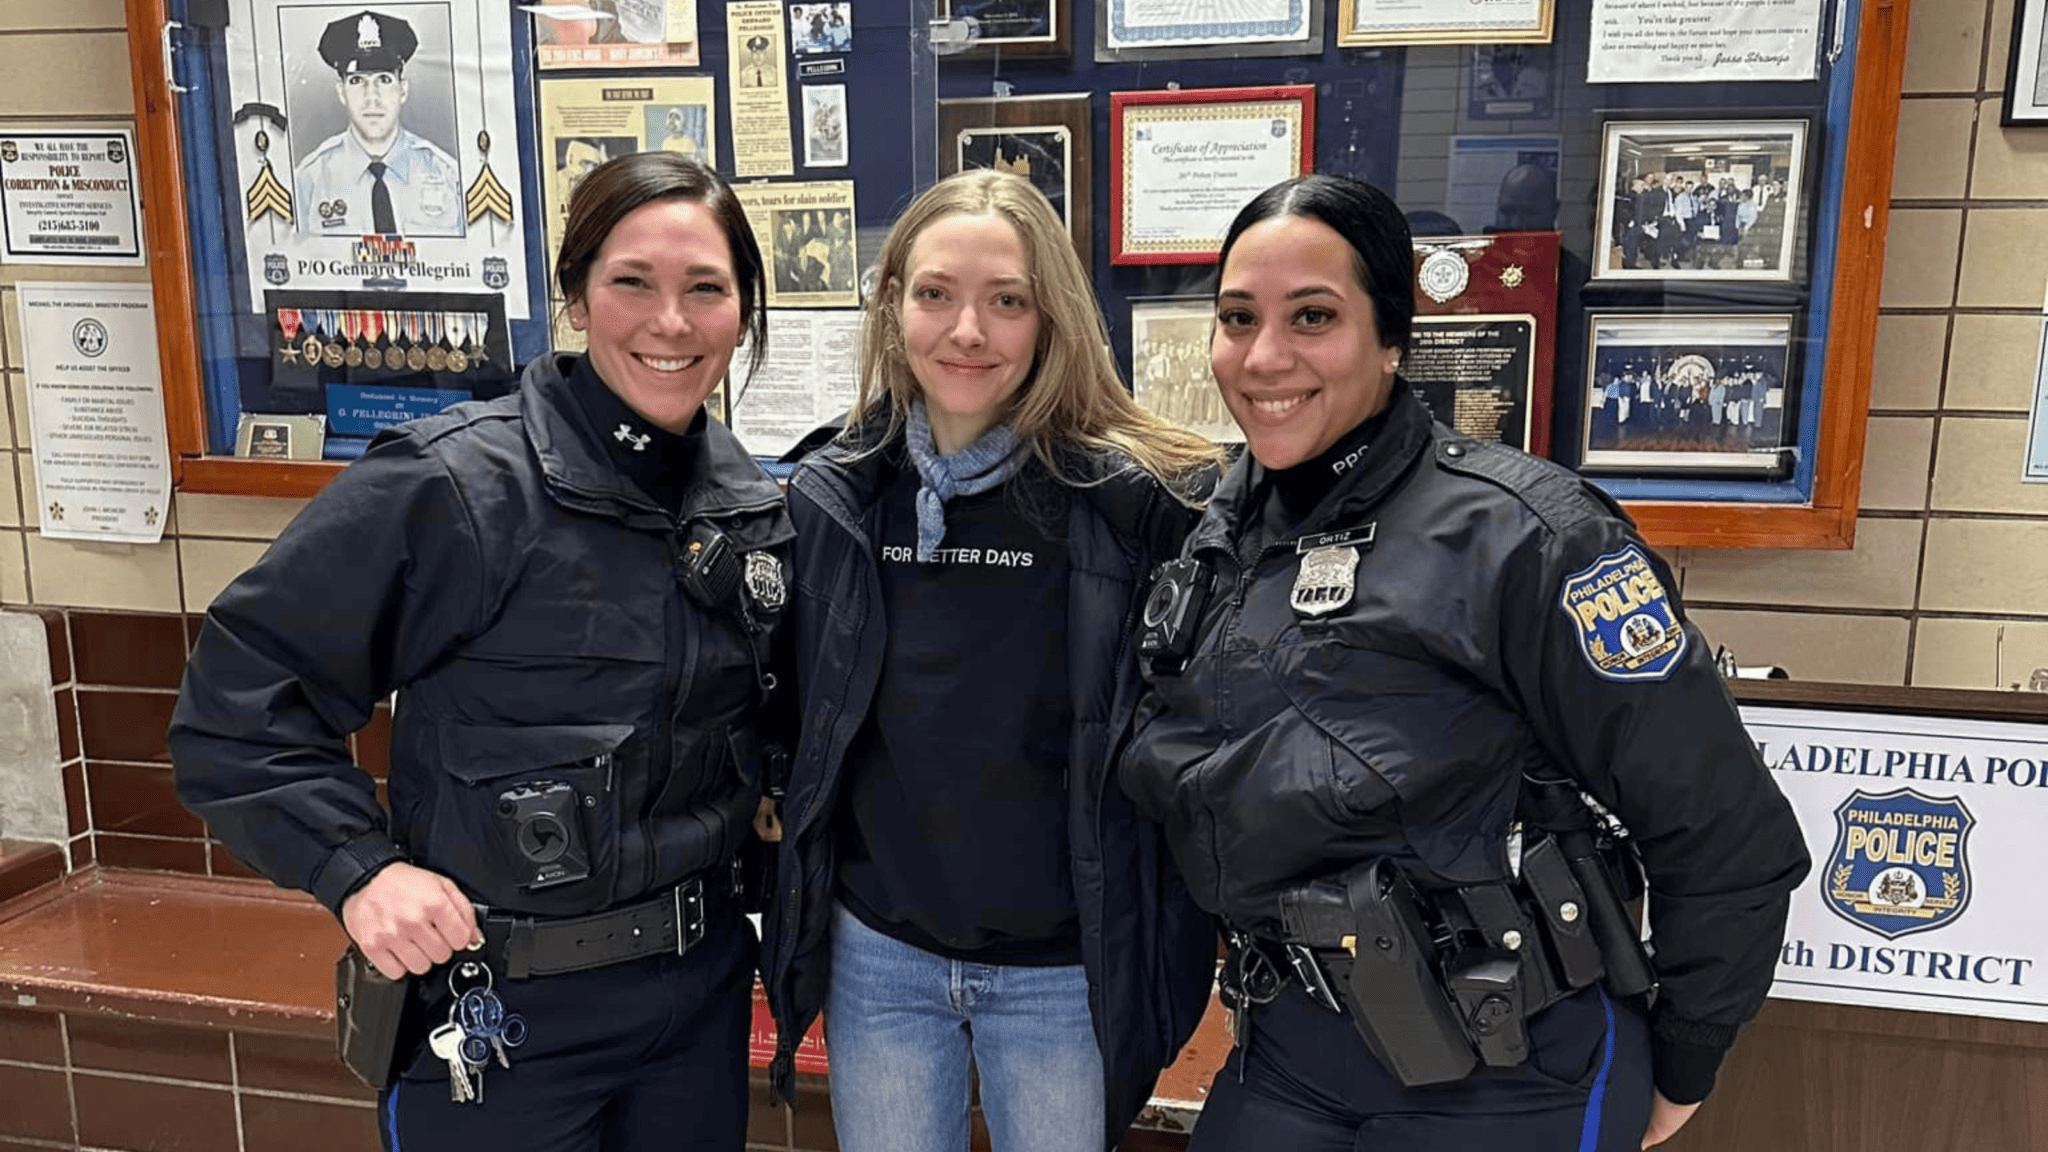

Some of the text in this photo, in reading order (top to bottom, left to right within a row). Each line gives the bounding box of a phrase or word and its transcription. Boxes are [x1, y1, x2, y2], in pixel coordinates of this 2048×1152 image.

[49, 165, 80, 177] POLICE
[5, 179, 128, 191] CORRUPTION & MISCONDUCT
[297, 259, 471, 281] P/O Gennaro Pellegrini
[1319, 531, 1351, 545] ORTIZ
[882, 546, 1034, 567] FOR ETTER DAYS
[1569, 558, 1647, 604] PHILADELPHIA
[1575, 569, 1665, 633] POLICE
[1757, 741, 1975, 784] LADELPHIA
[1847, 808, 1959, 830] PHILADELPHIA
[1845, 826, 1958, 868] POLICE
[1873, 906, 1917, 915] INTEGRITY
[1782, 940, 2032, 986] th DISTRICT
